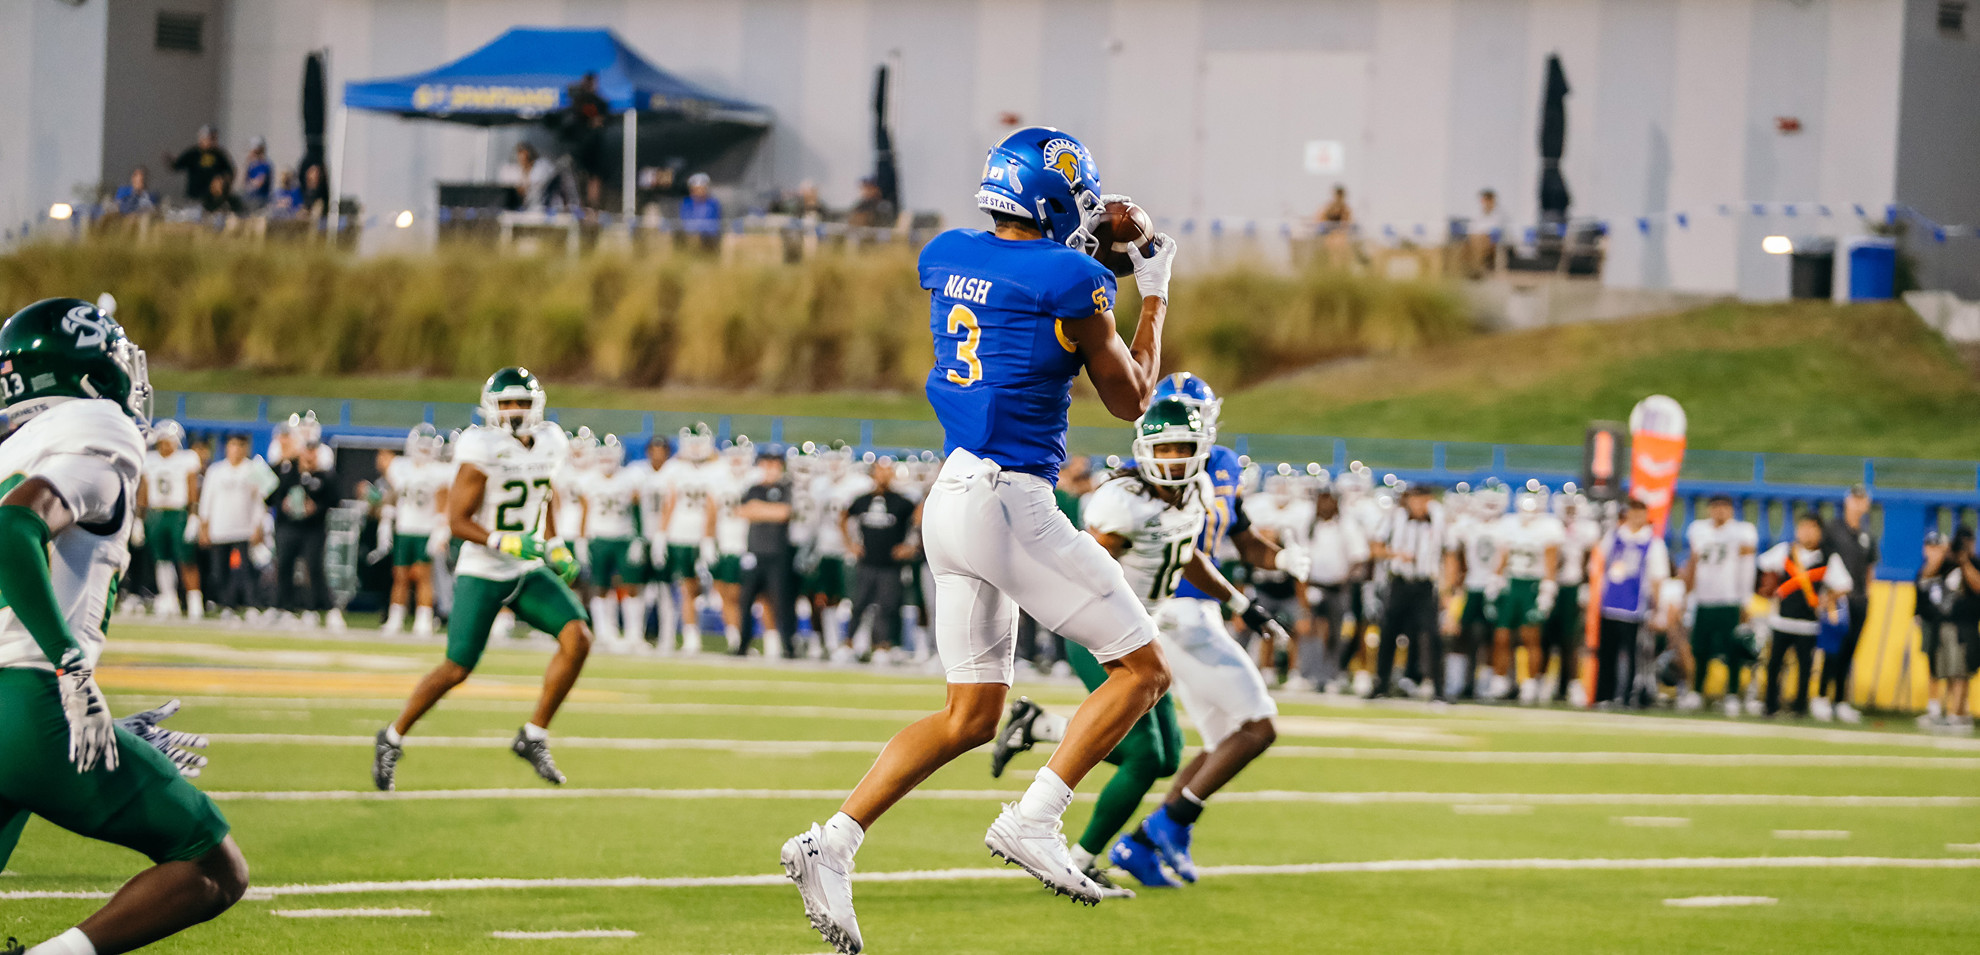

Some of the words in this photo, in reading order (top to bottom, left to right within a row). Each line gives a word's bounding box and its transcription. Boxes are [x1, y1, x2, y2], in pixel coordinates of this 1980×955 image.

[990, 197, 1016, 212] STATE
[944, 274, 993, 304] NASH
[947, 303, 983, 387] 3
[0, 372, 25, 399] 13
[497, 477, 552, 531] 27
